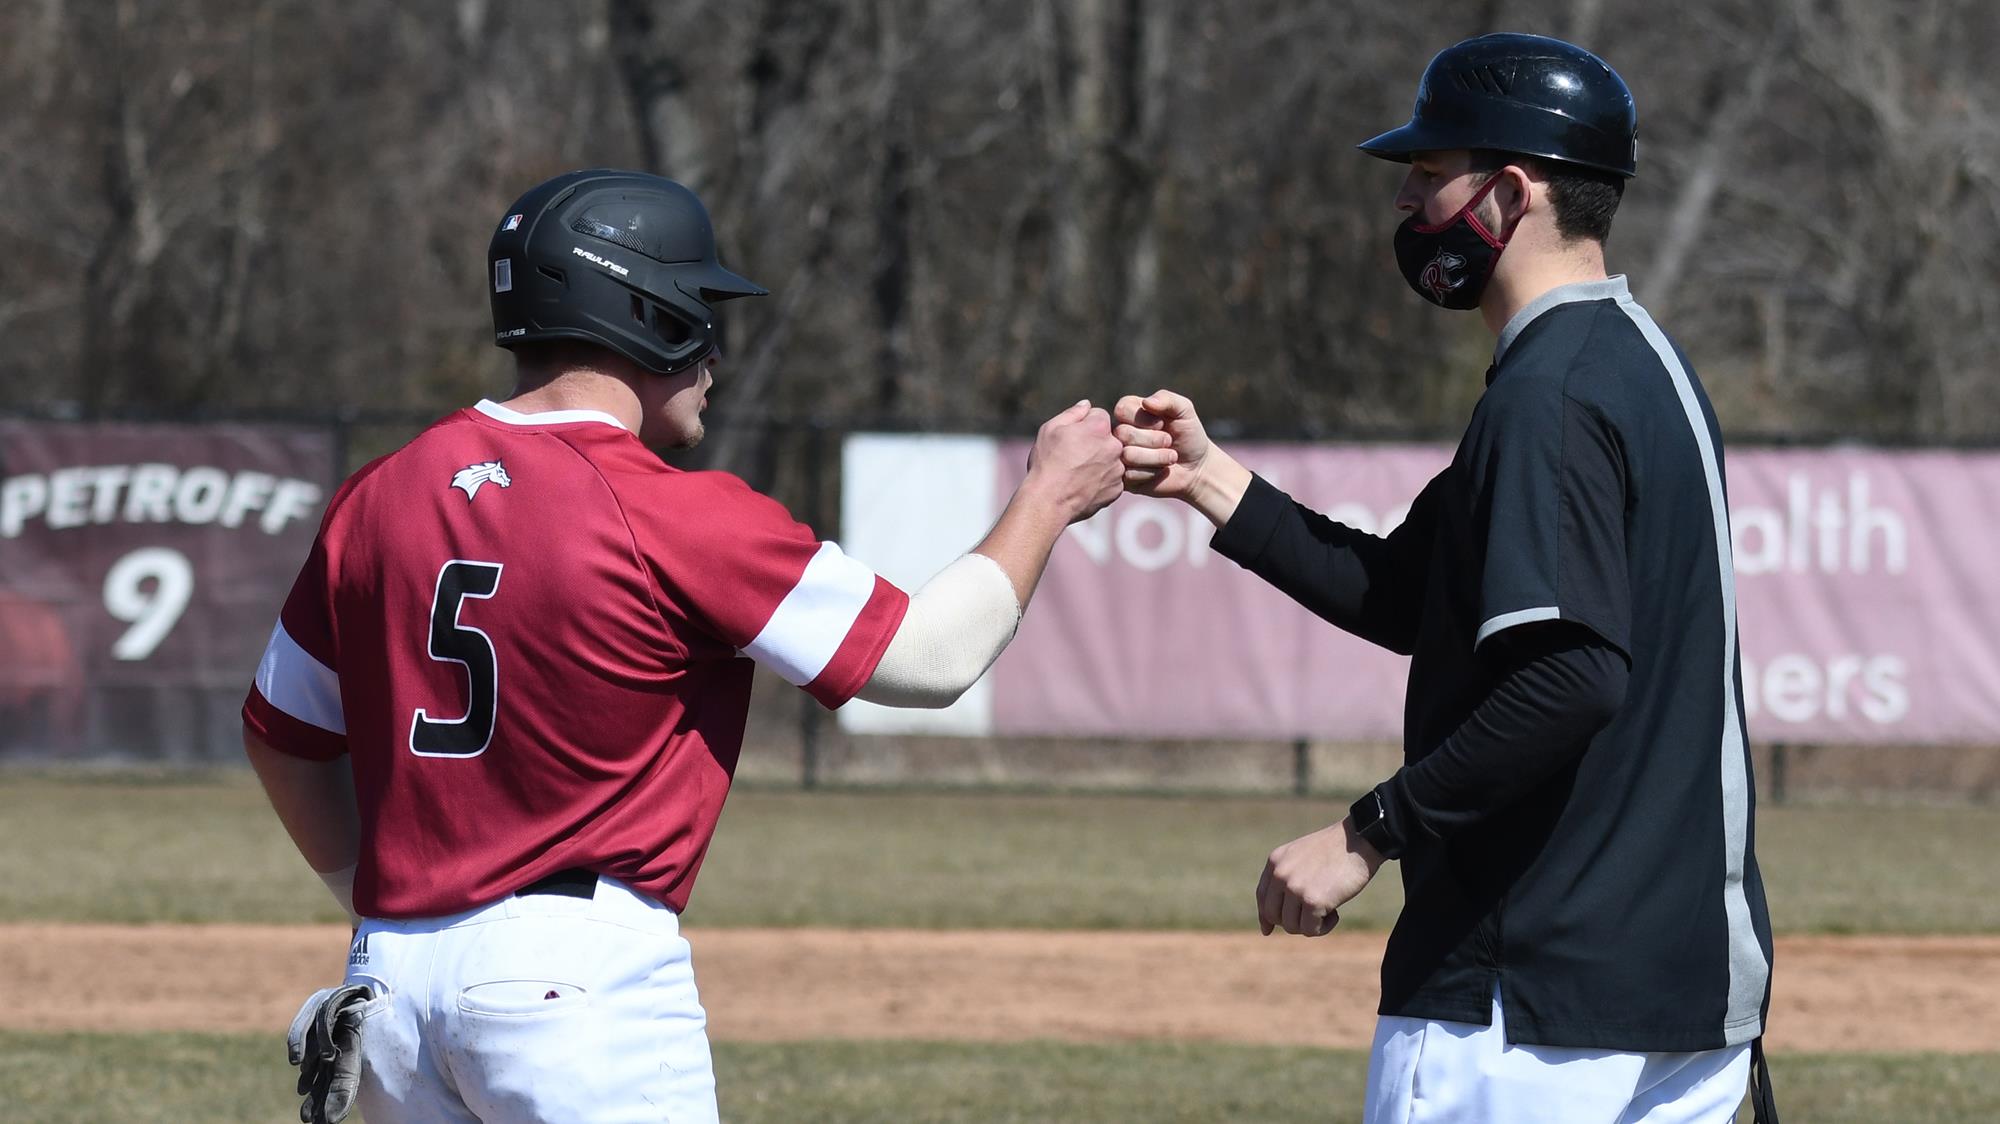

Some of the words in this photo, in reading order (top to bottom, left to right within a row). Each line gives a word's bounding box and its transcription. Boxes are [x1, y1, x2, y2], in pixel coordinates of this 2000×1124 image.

[572, 247, 629, 276] RAWLINGS
[0, 463, 322, 538] PETROFF
[103, 547, 194, 661] 9
[410, 559, 504, 759] 5
